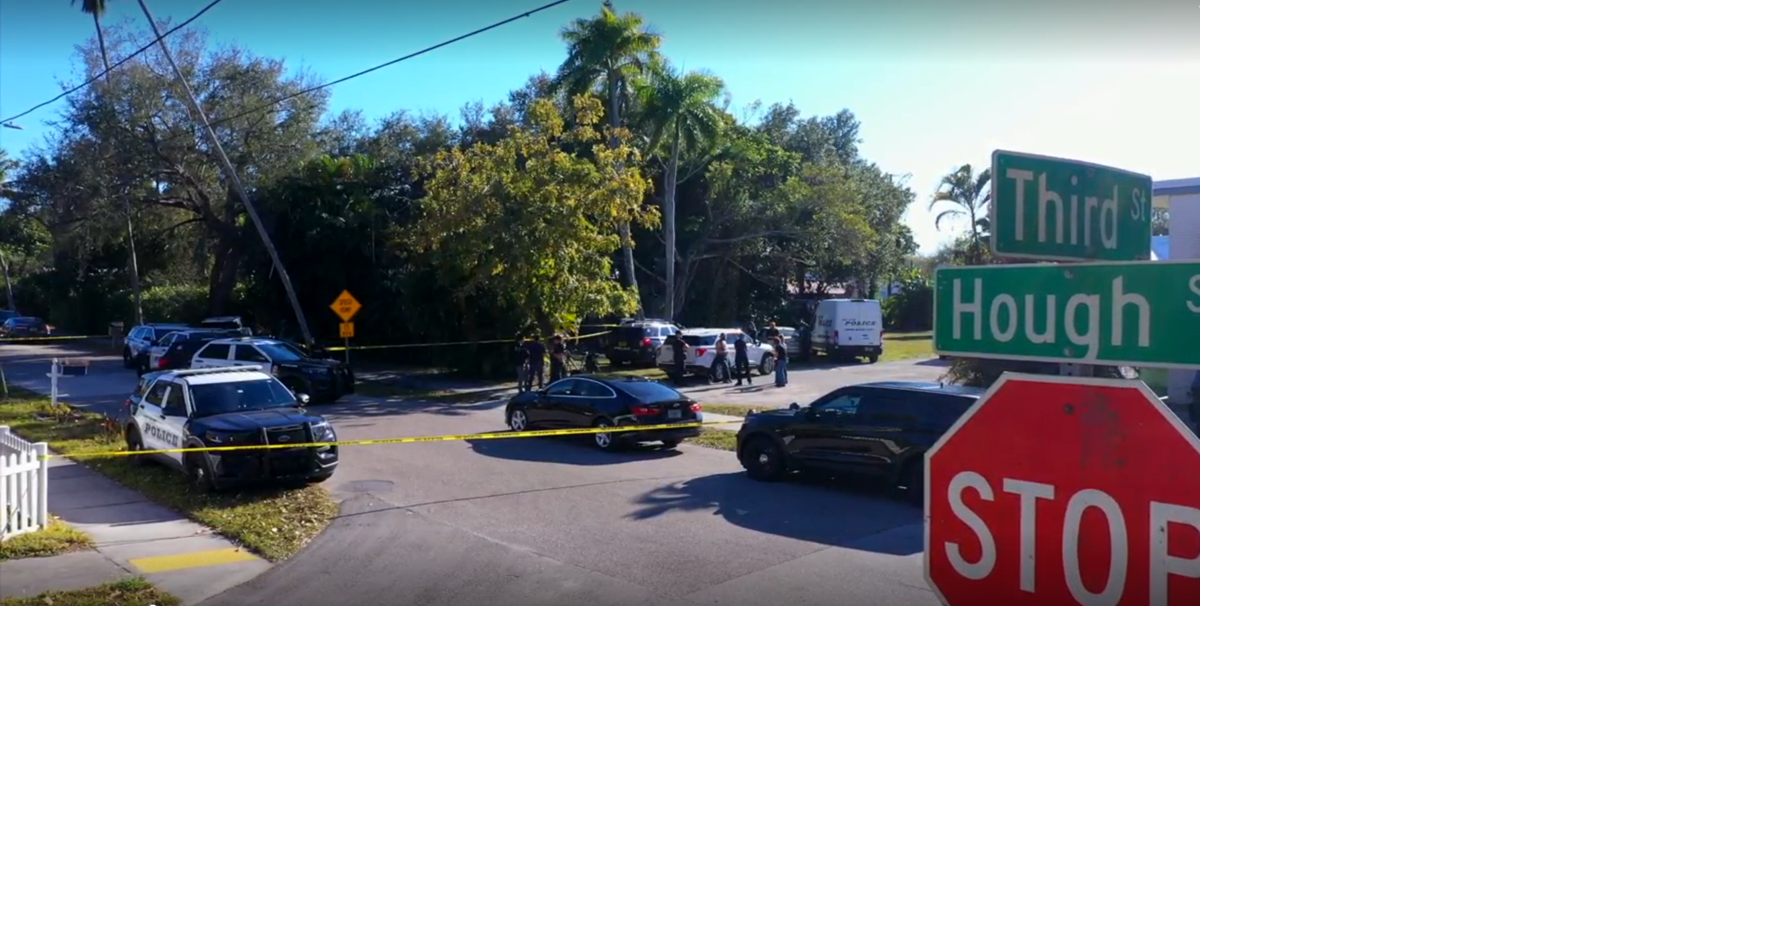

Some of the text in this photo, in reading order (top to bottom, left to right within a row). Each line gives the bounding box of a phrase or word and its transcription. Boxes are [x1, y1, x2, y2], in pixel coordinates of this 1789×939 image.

[1006, 168, 1146, 249] Third St
[952, 275, 1151, 360] Hough
[144, 422, 179, 447] POLICE
[944, 470, 1200, 606] STOP
